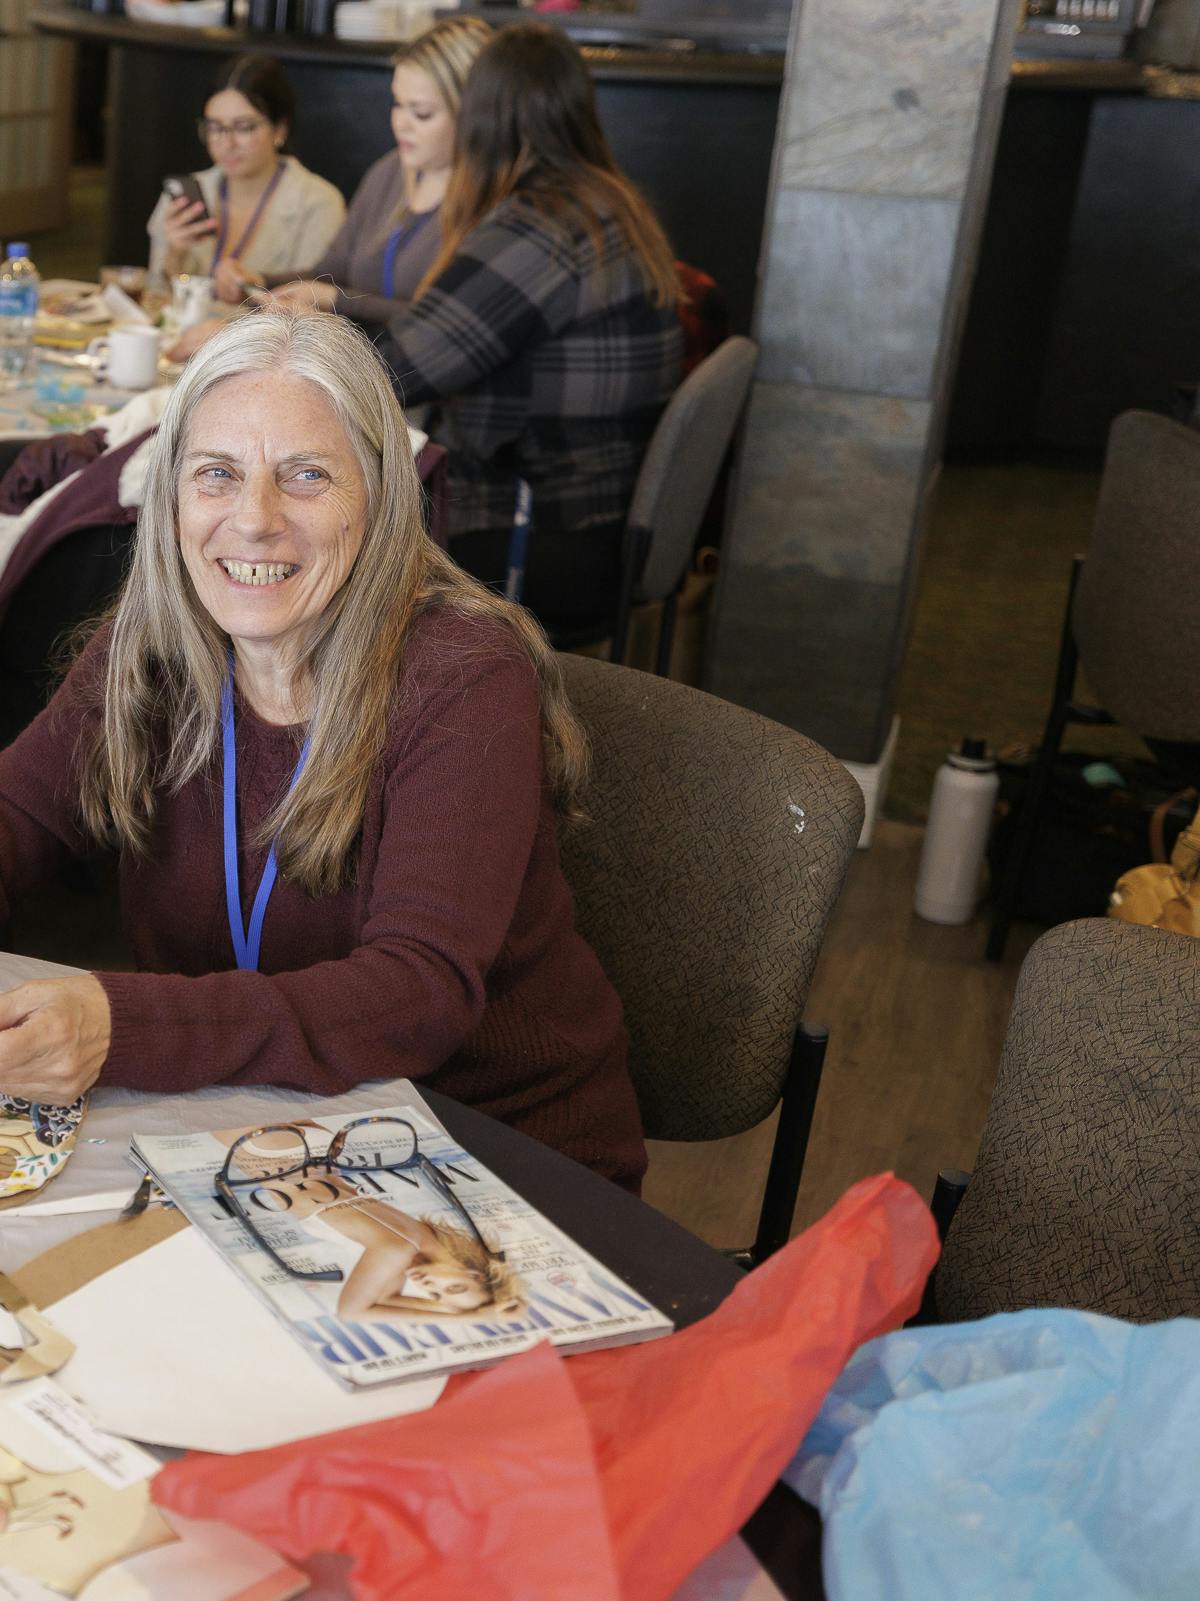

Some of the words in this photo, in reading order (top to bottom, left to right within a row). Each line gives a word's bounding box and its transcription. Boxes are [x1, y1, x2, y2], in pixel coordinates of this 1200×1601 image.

[212, 1163, 481, 1219] MARGOT
[241, 1235, 301, 1249] SCHOL
[296, 1319, 451, 1363] FAIR
